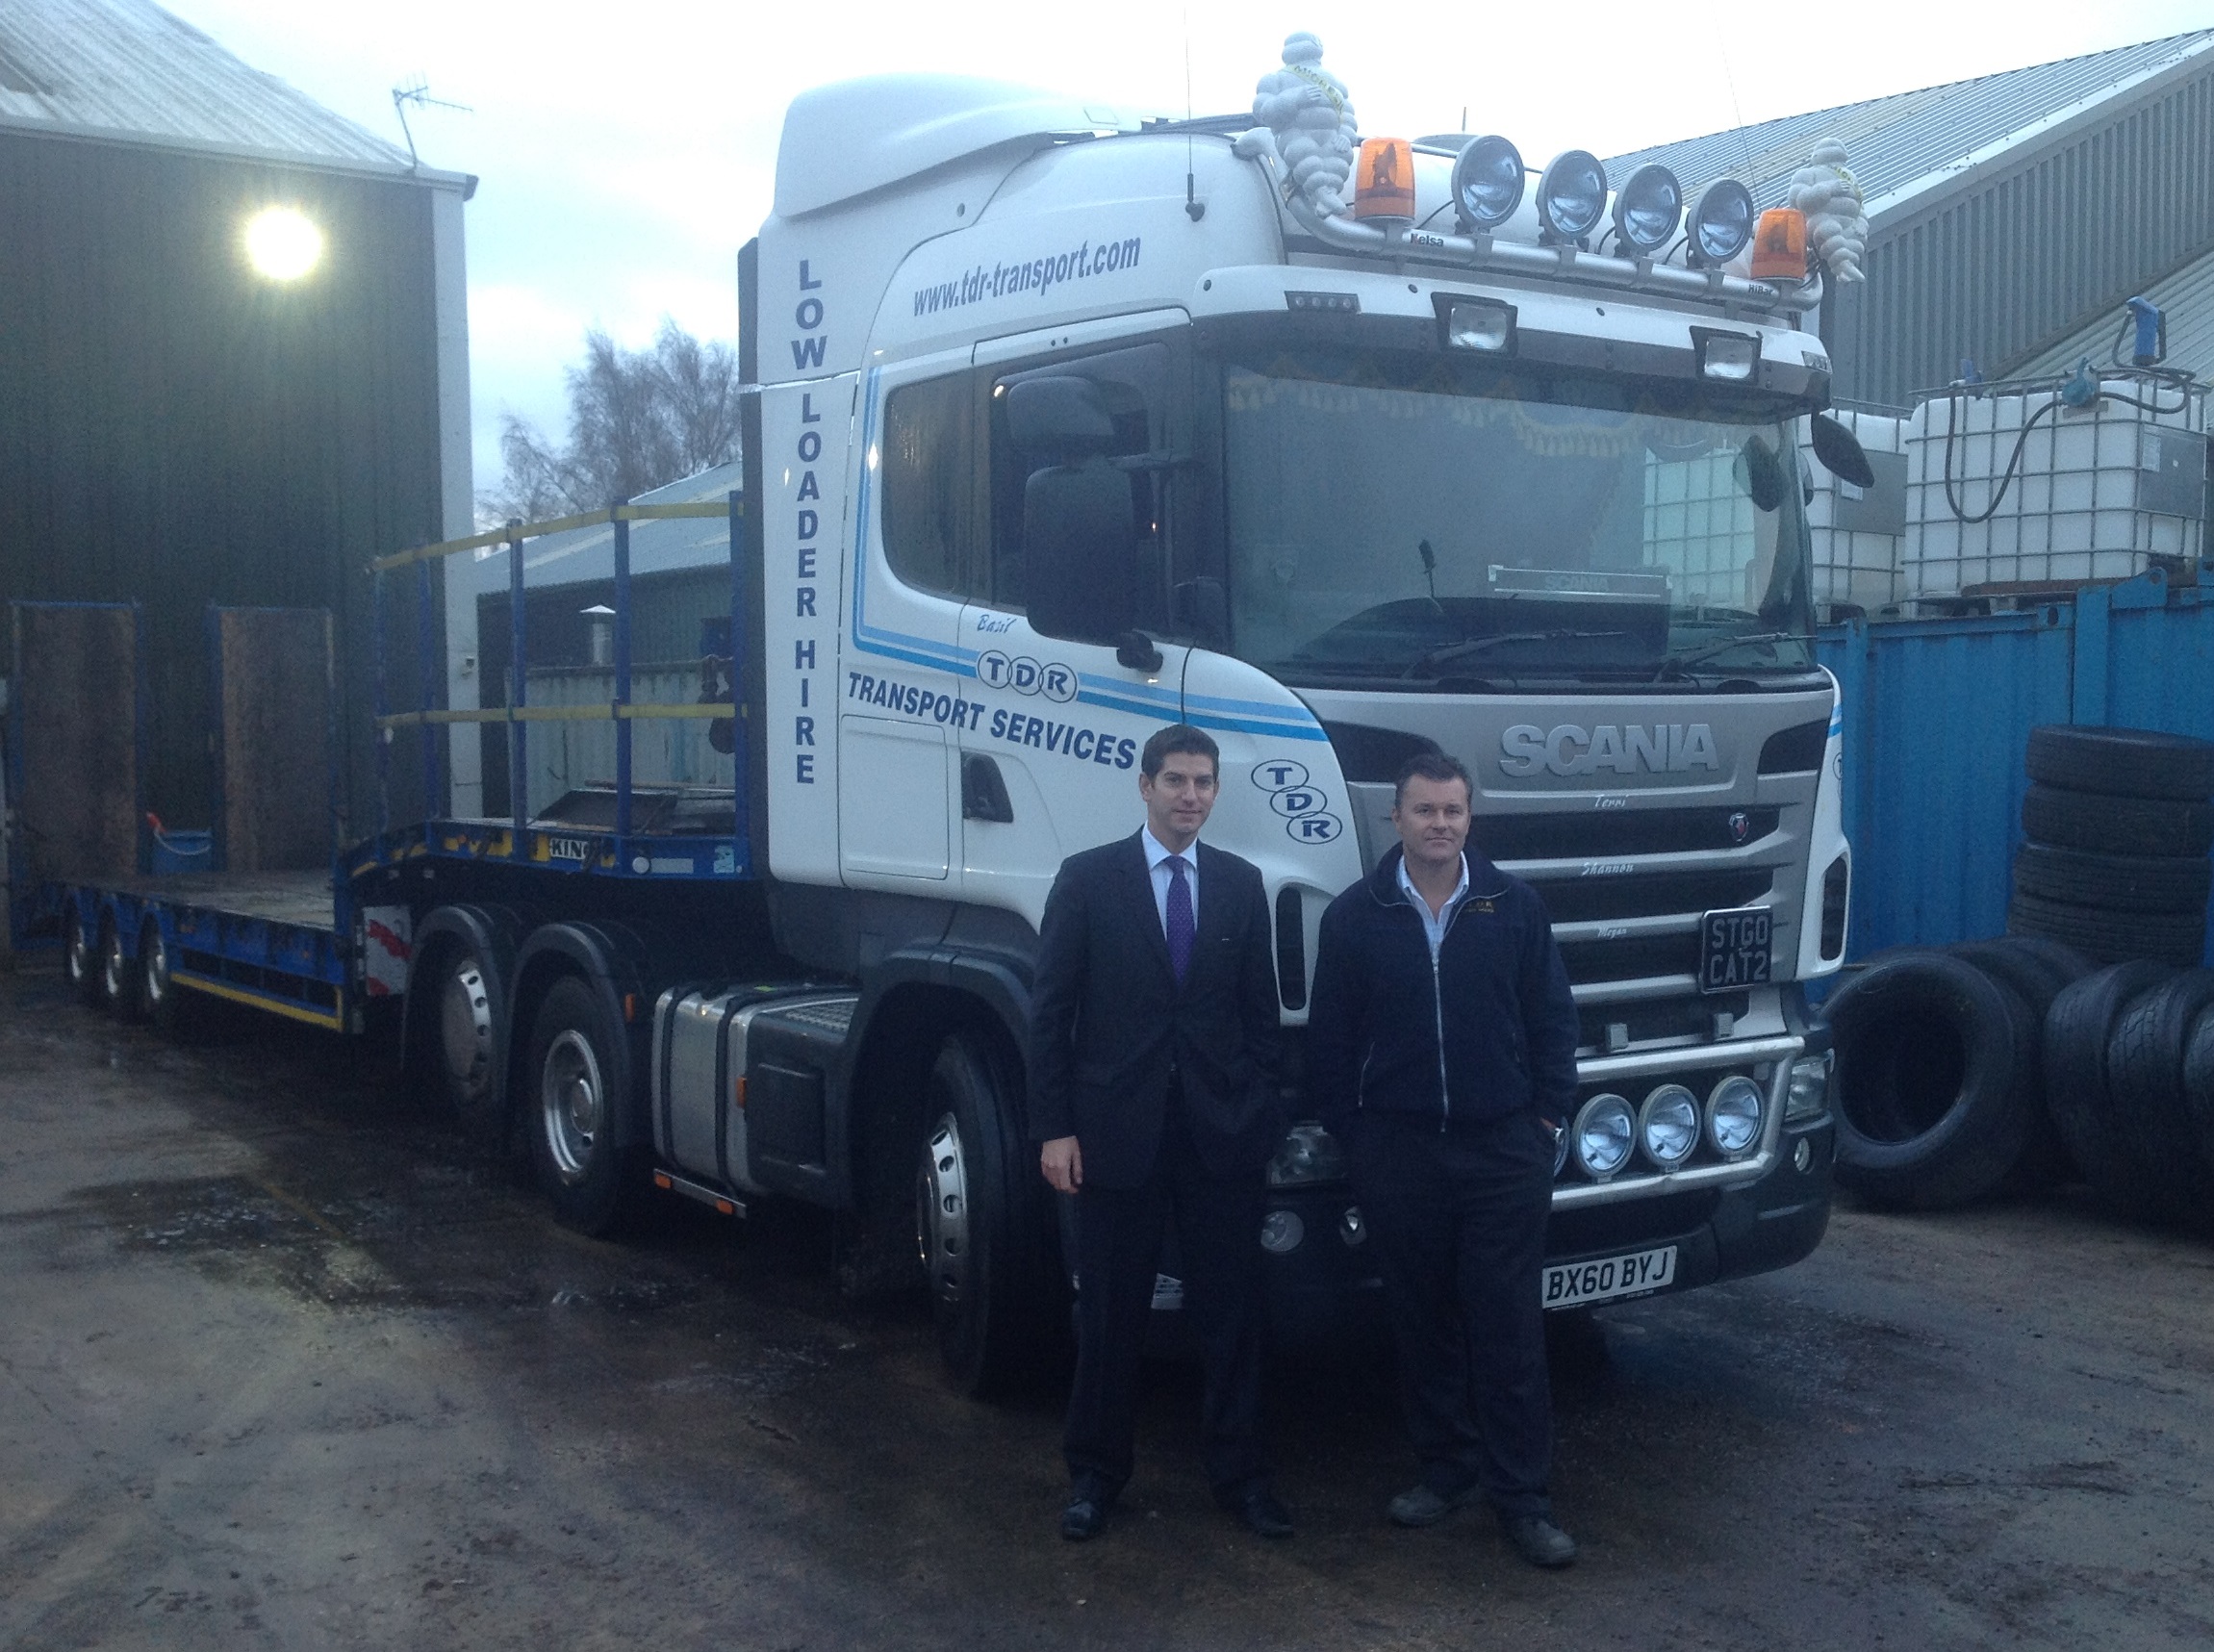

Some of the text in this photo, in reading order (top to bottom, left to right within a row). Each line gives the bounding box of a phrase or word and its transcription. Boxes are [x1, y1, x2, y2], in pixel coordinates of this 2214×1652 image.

[1411, 233, 1444, 247] Kelsa
[913, 237, 1142, 317] www.tdr-transport.com
[790, 259, 827, 784] LOW LOADER HIRE
[977, 614, 1017, 634] Basil
[986, 656, 1068, 696] TDR
[848, 672, 1137, 771] TRANSPORT SERVICES
[1498, 724, 1720, 777] SCANIA
[1581, 861, 1635, 877] Shannon
[1712, 915, 1769, 950] STGO
[1710, 949, 1768, 985] CAT2
[1546, 1251, 1668, 1302] BX60 BYJ
